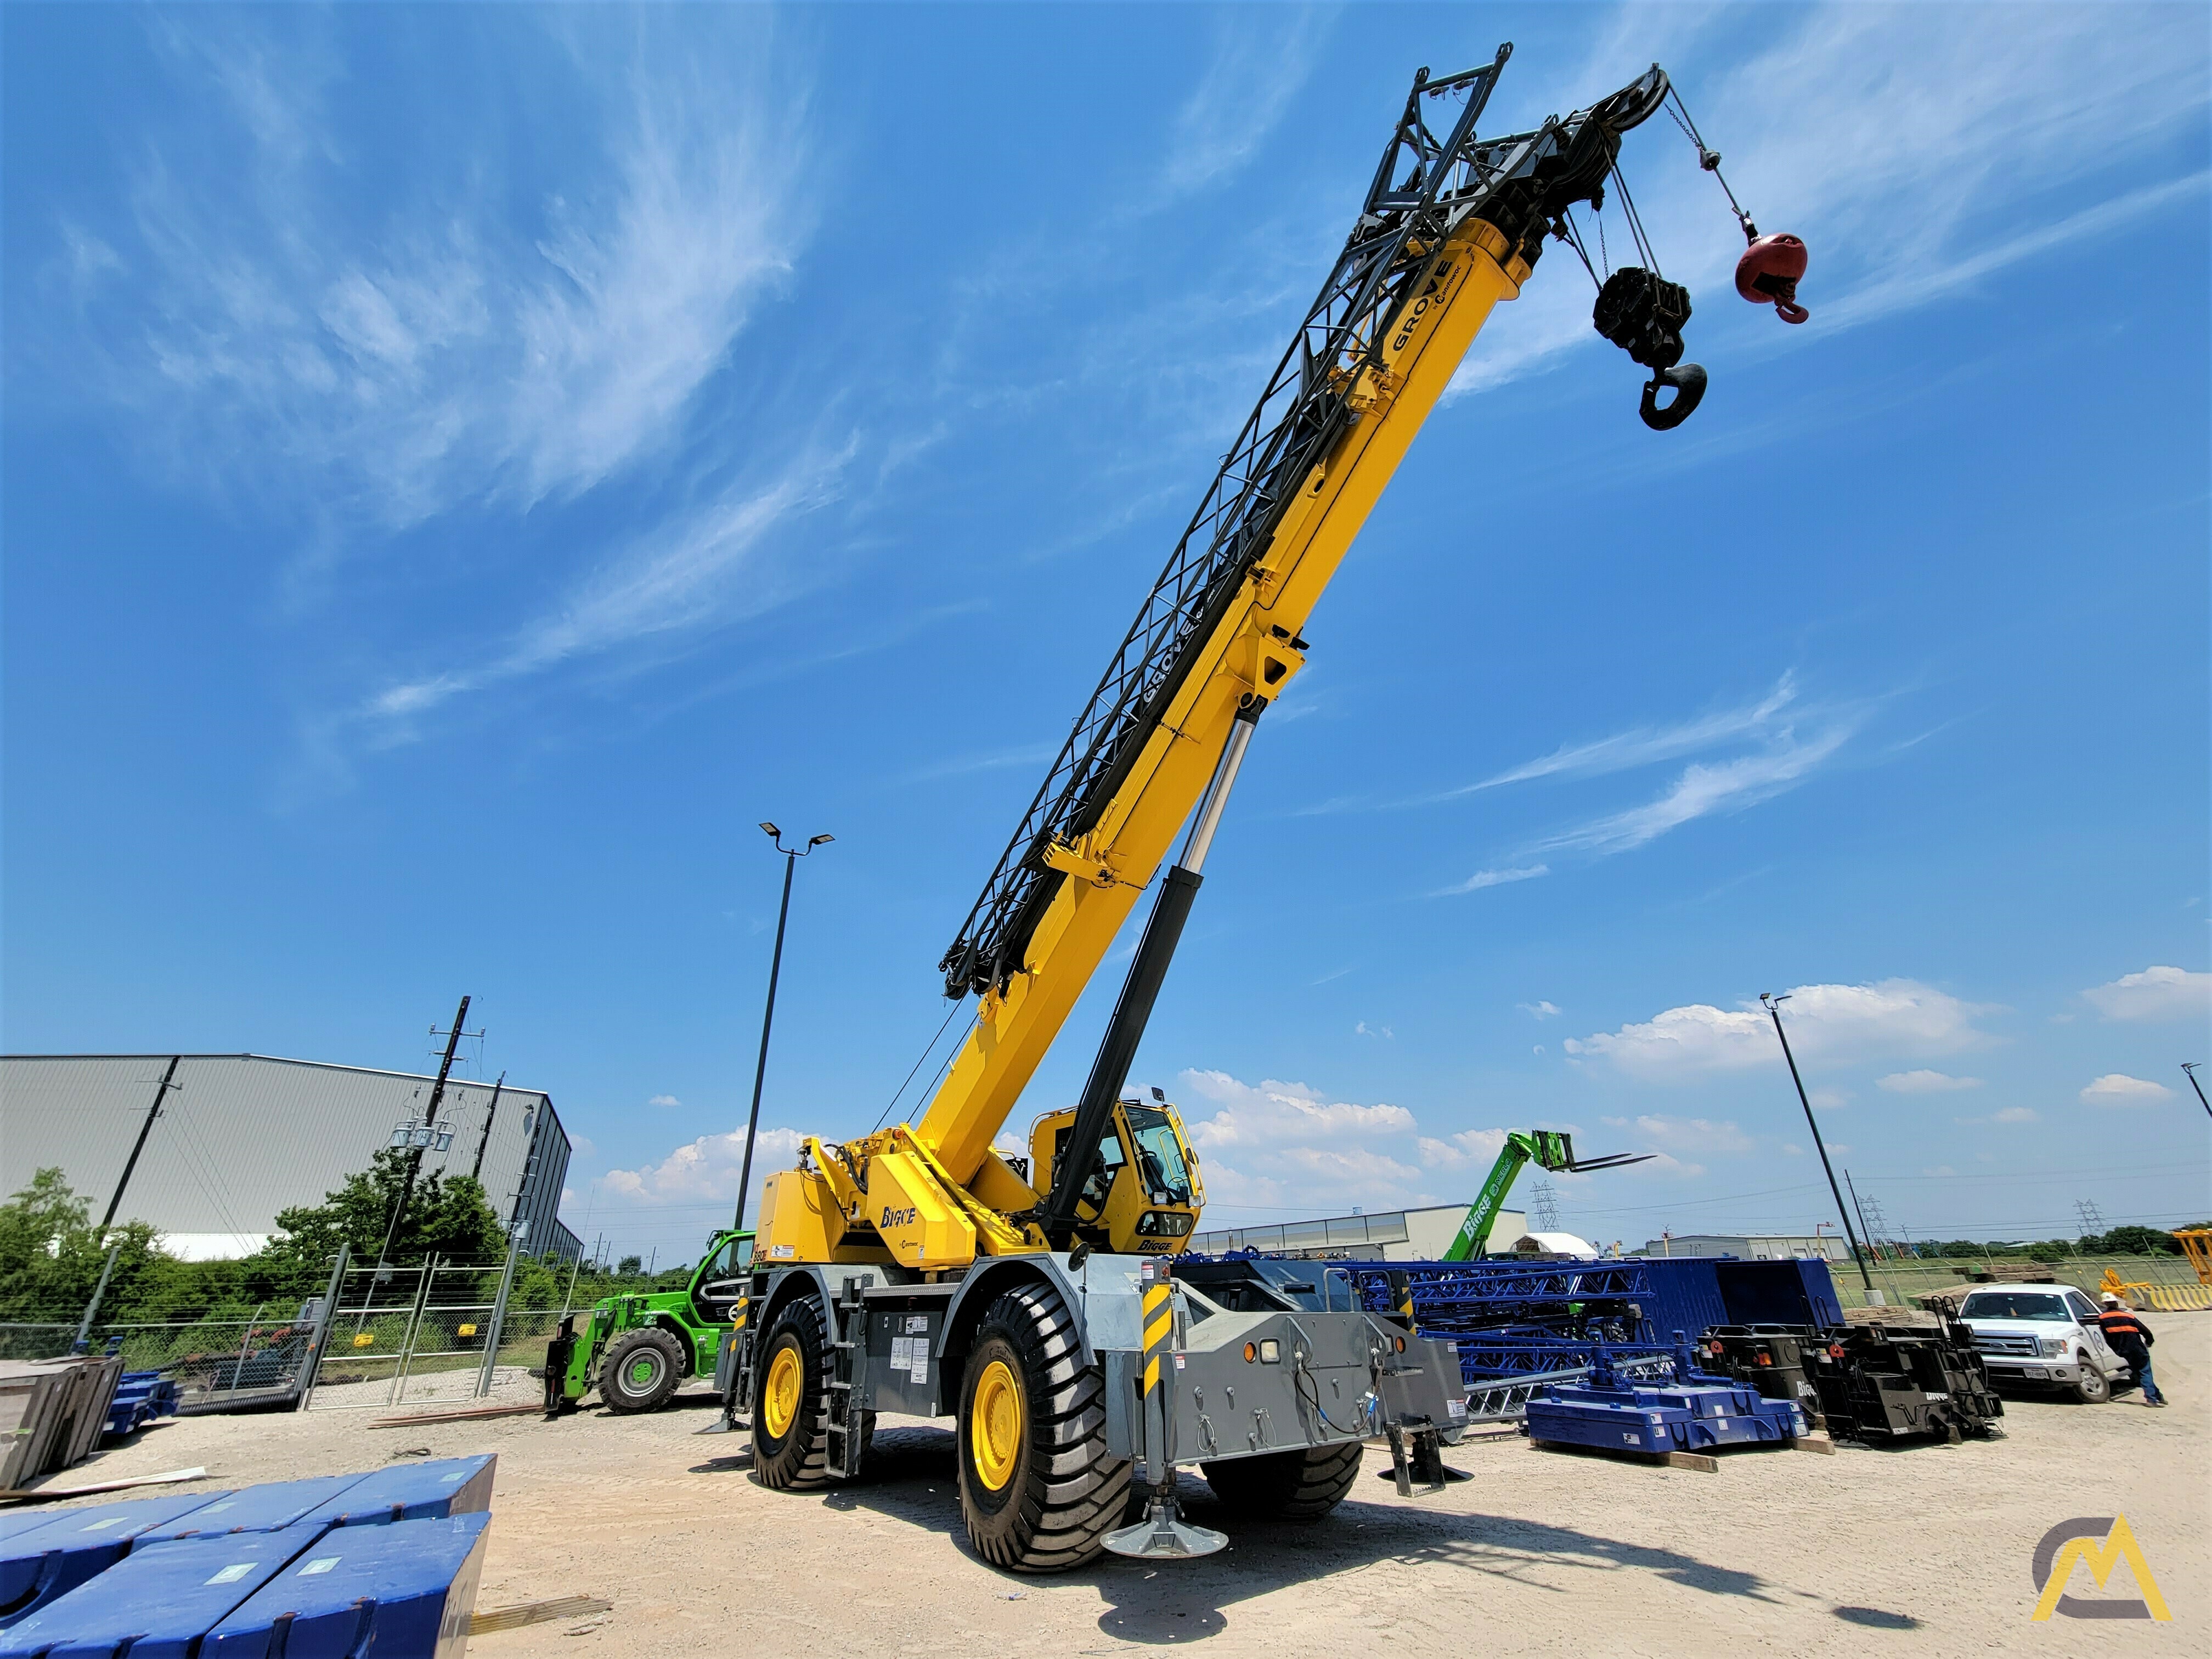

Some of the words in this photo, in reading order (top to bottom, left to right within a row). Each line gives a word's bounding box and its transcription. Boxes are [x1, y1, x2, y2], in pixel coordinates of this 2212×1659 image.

[1393, 260, 1453, 351] GROVE
[1435, 265, 1462, 304] Manitowoc
[1143, 620, 1194, 703] GROVE
[1496, 1159, 1511, 1184] MERLO
